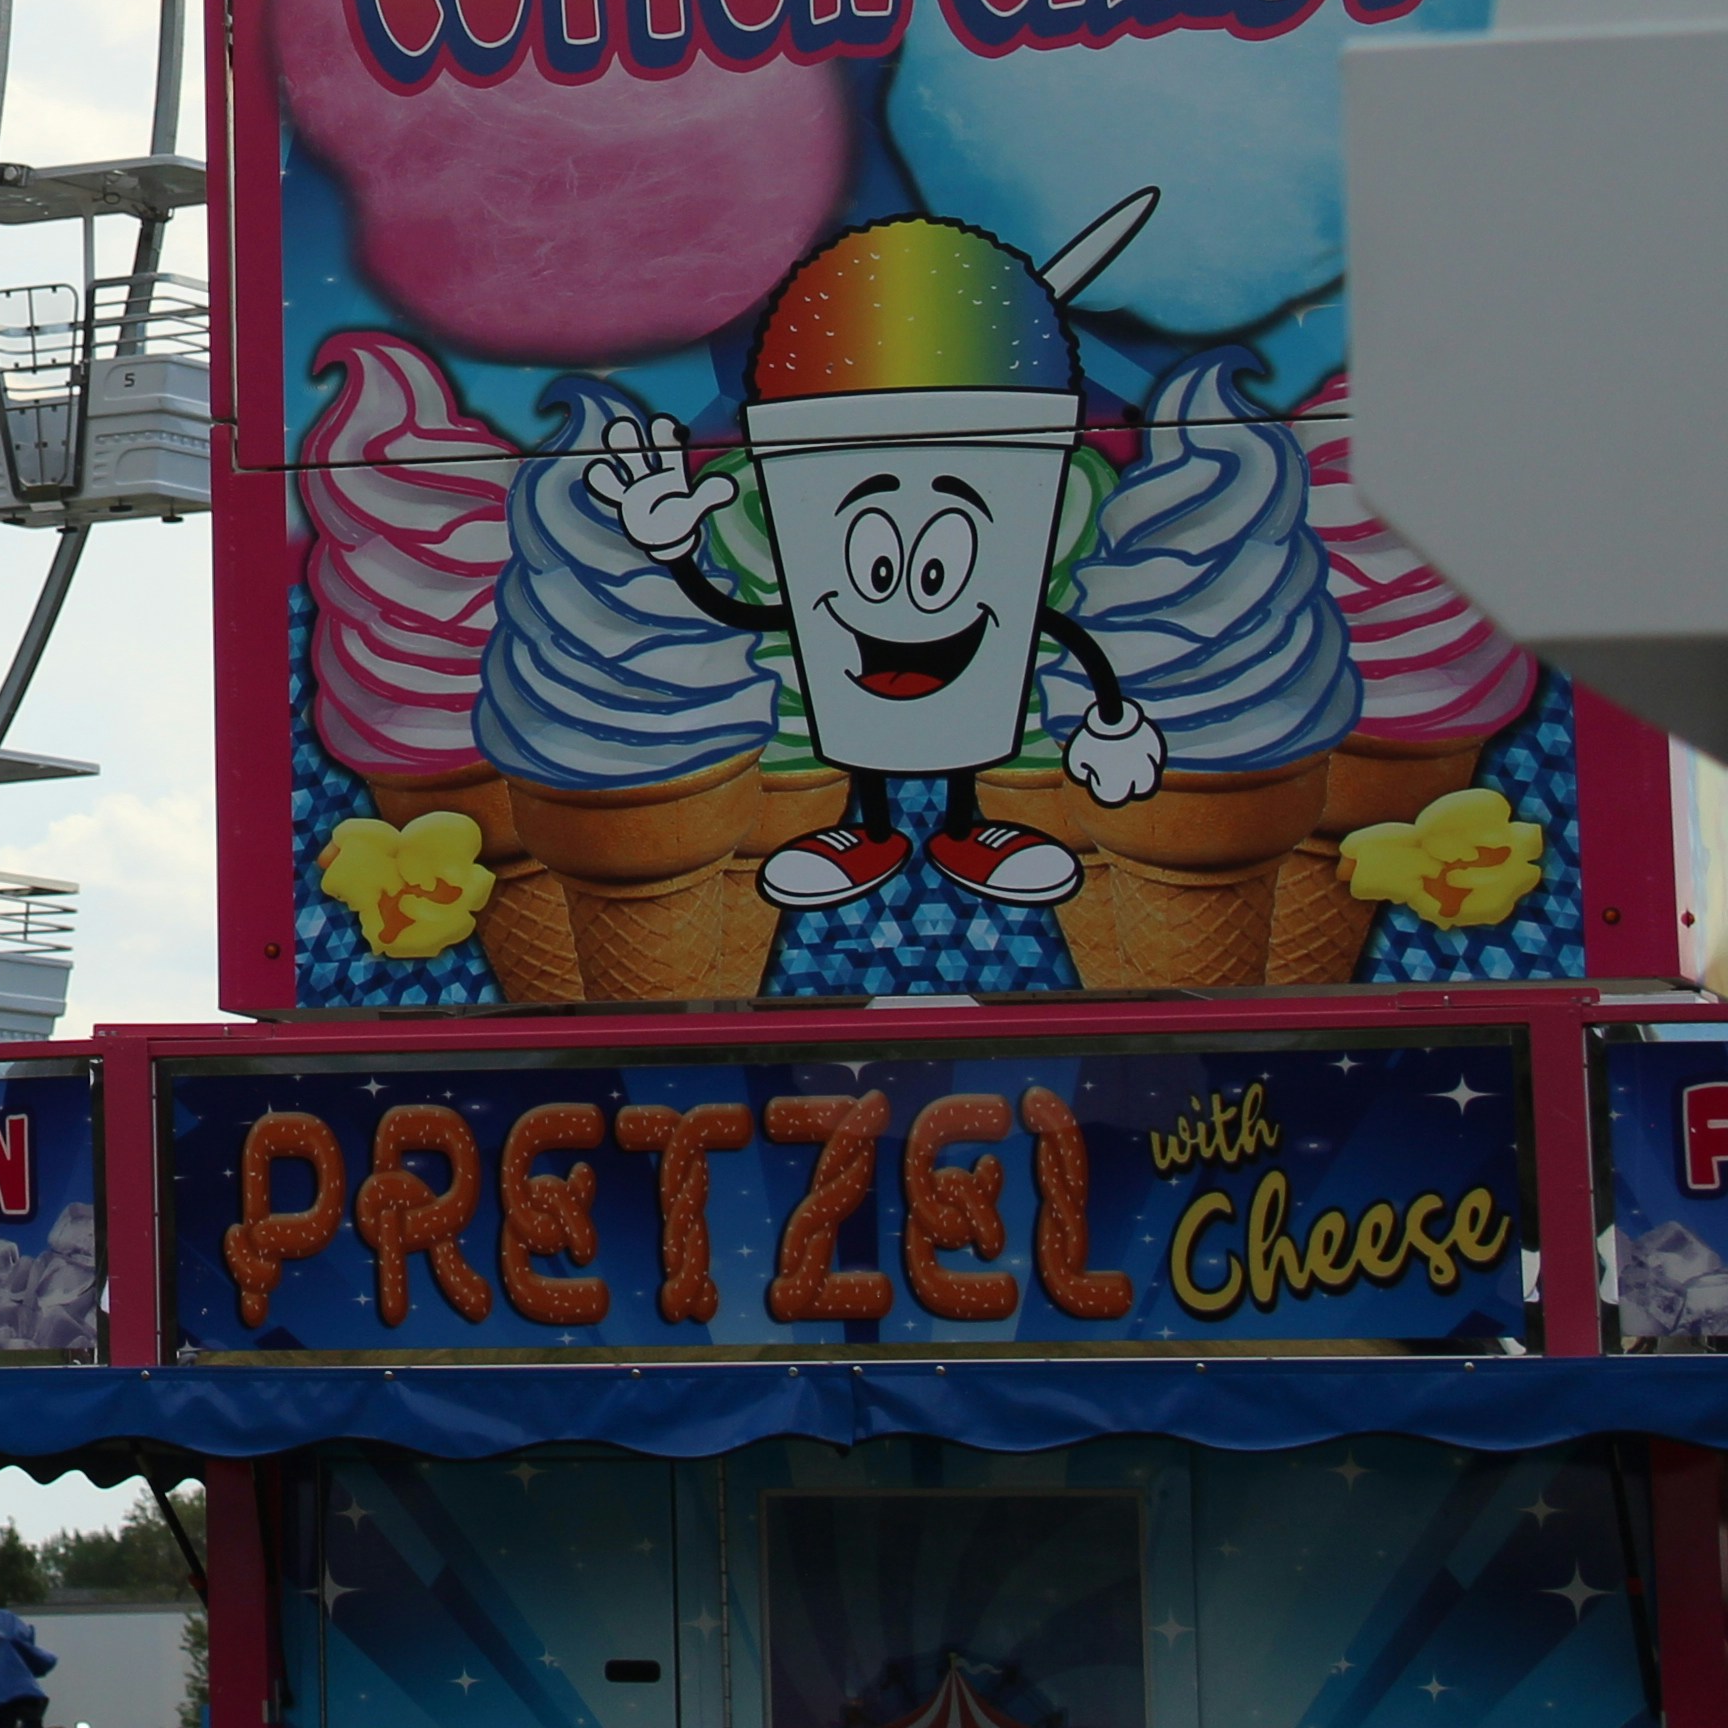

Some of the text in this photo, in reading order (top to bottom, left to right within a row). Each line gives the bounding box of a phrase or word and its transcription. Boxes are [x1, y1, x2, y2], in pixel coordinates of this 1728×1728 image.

[124, 372, 136, 388] 5
[1149, 1081, 1280, 1174] with
[223, 1085, 1134, 1332] PRETZEL
[1170, 1170, 1511, 1315] Cheese
